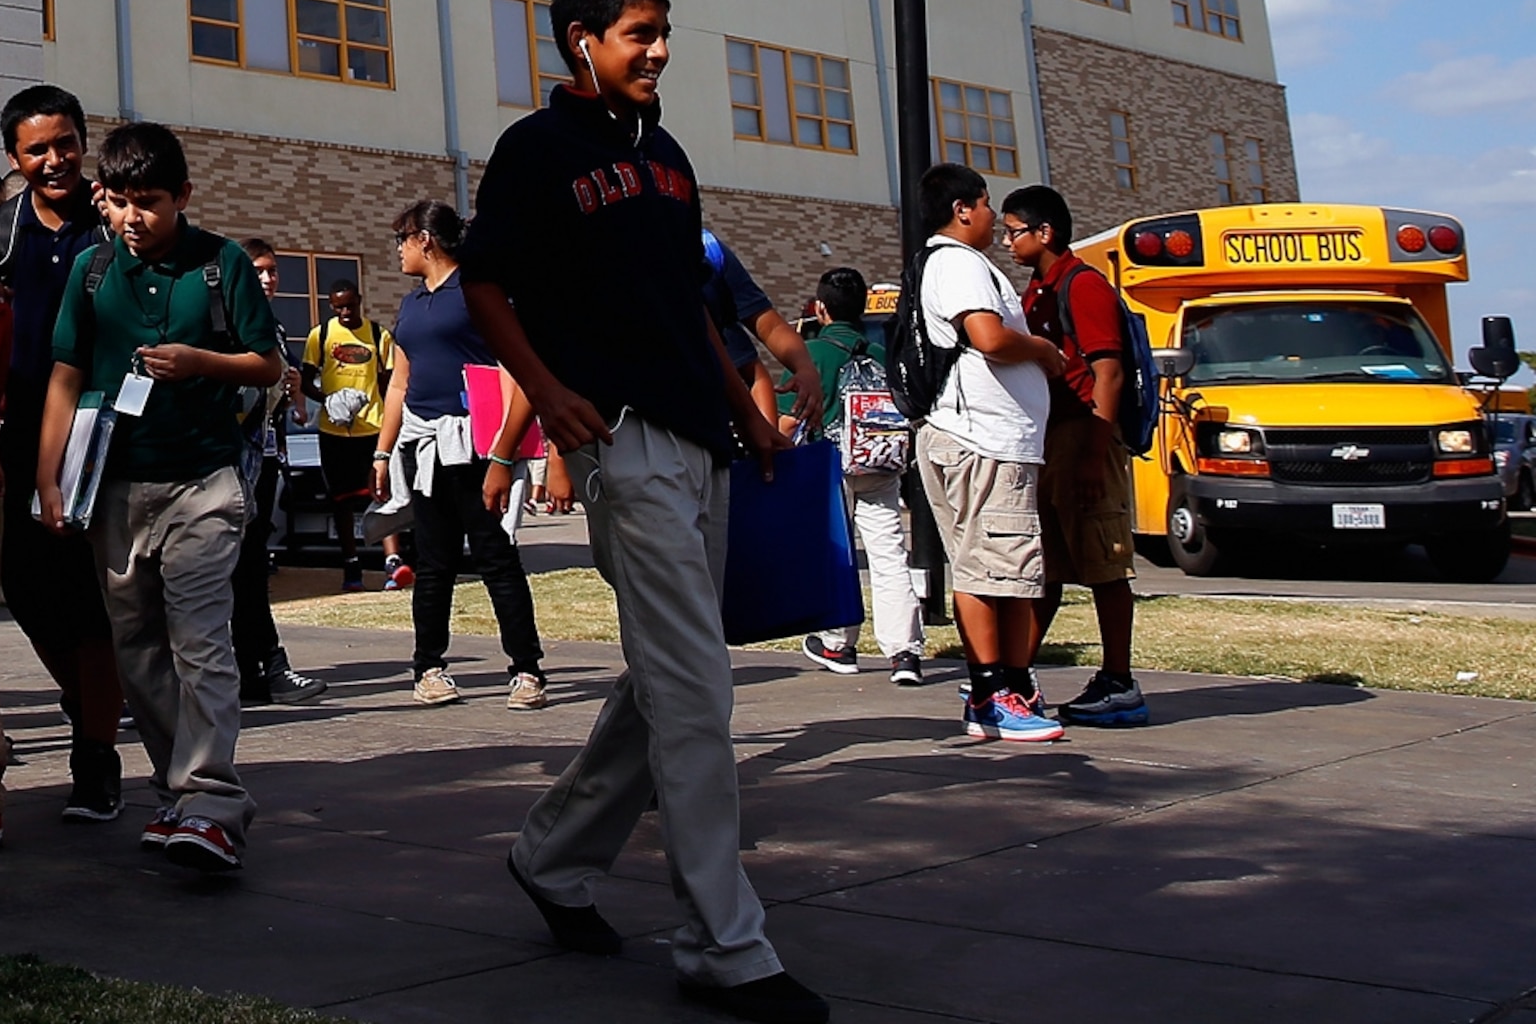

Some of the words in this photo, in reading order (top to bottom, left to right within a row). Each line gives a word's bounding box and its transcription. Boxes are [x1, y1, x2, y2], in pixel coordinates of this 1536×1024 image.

[571, 160, 644, 216] OLD
[1227, 233, 1313, 264] SCHOOL
[1317, 232, 1362, 262] BUS
[875, 295, 898, 310] BUS
